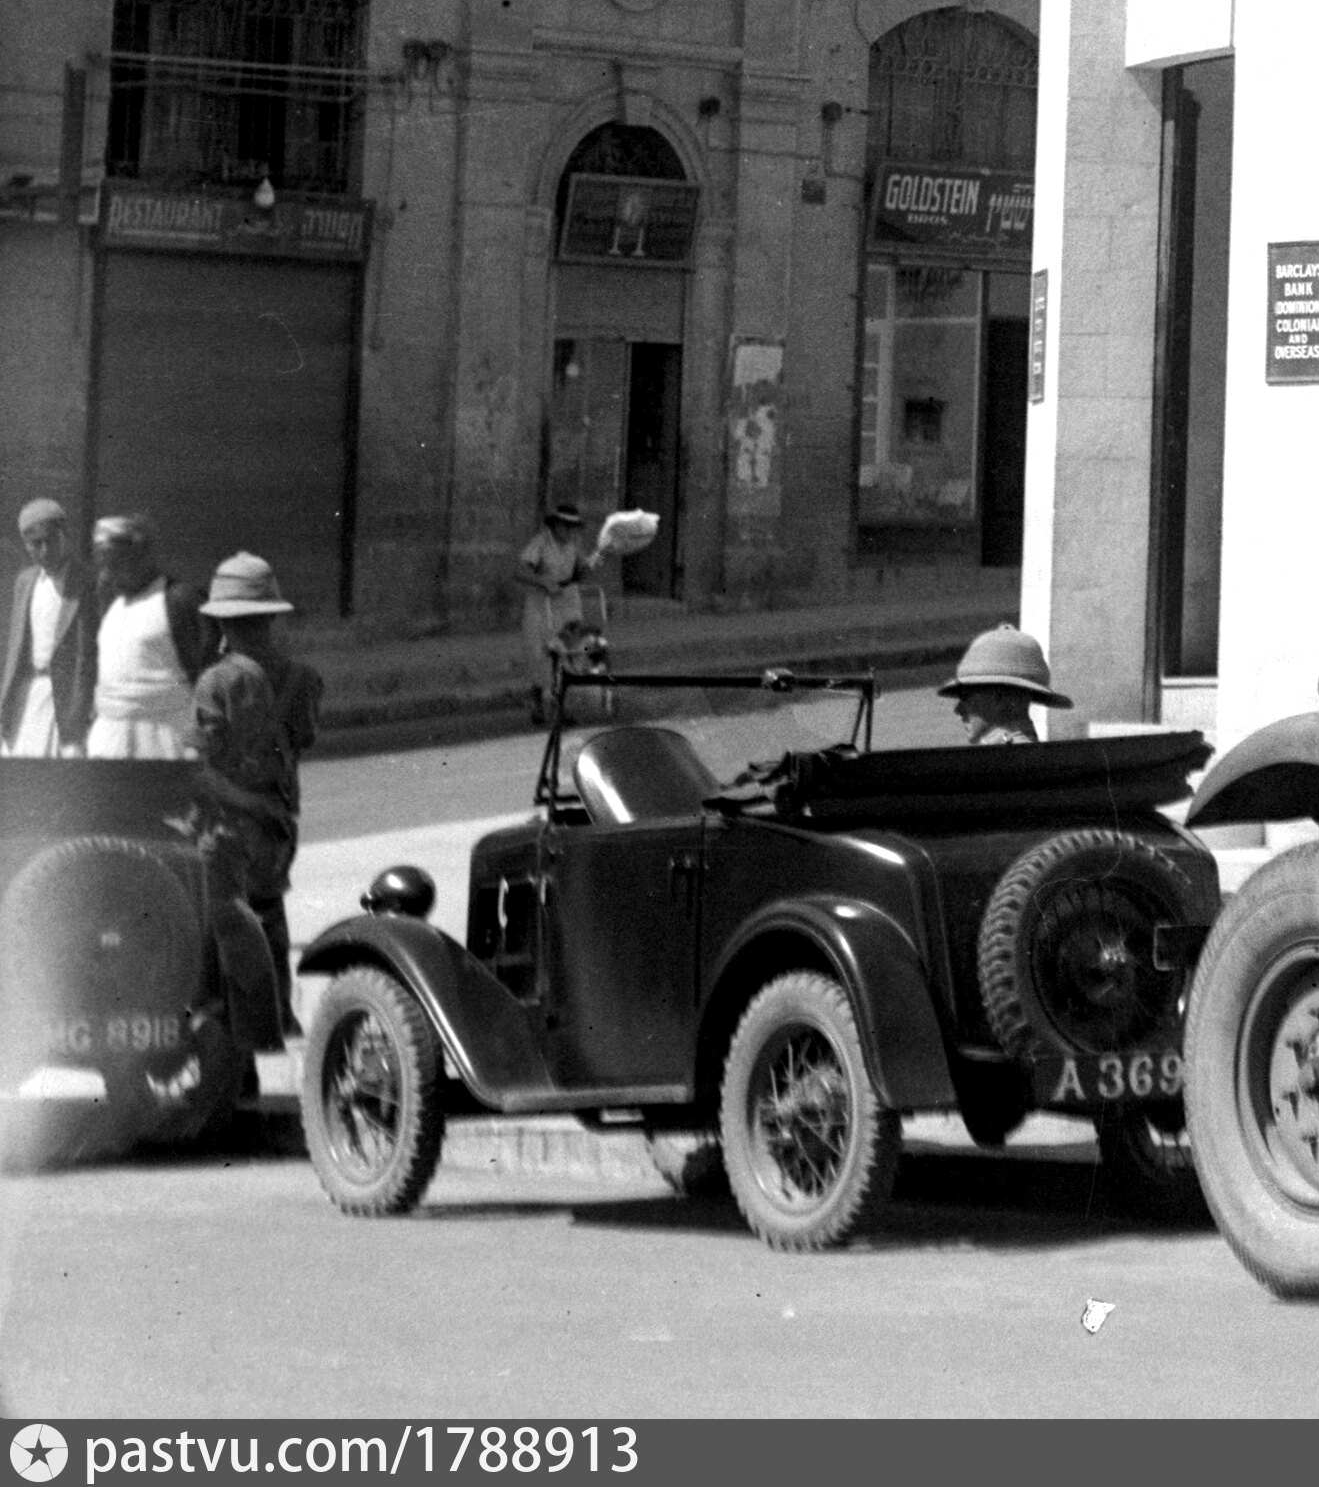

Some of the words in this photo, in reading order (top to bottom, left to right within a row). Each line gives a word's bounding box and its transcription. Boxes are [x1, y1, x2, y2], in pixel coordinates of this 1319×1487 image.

[107, 193, 225, 234] RESTAURANT
[884, 173, 981, 215] GOLDSTEIN
[1284, 282, 1314, 297] BANK
[1288, 333, 1308, 344] AND
[1051, 1058, 1087, 1101] A
[1098, 1053, 1185, 1100] 369
